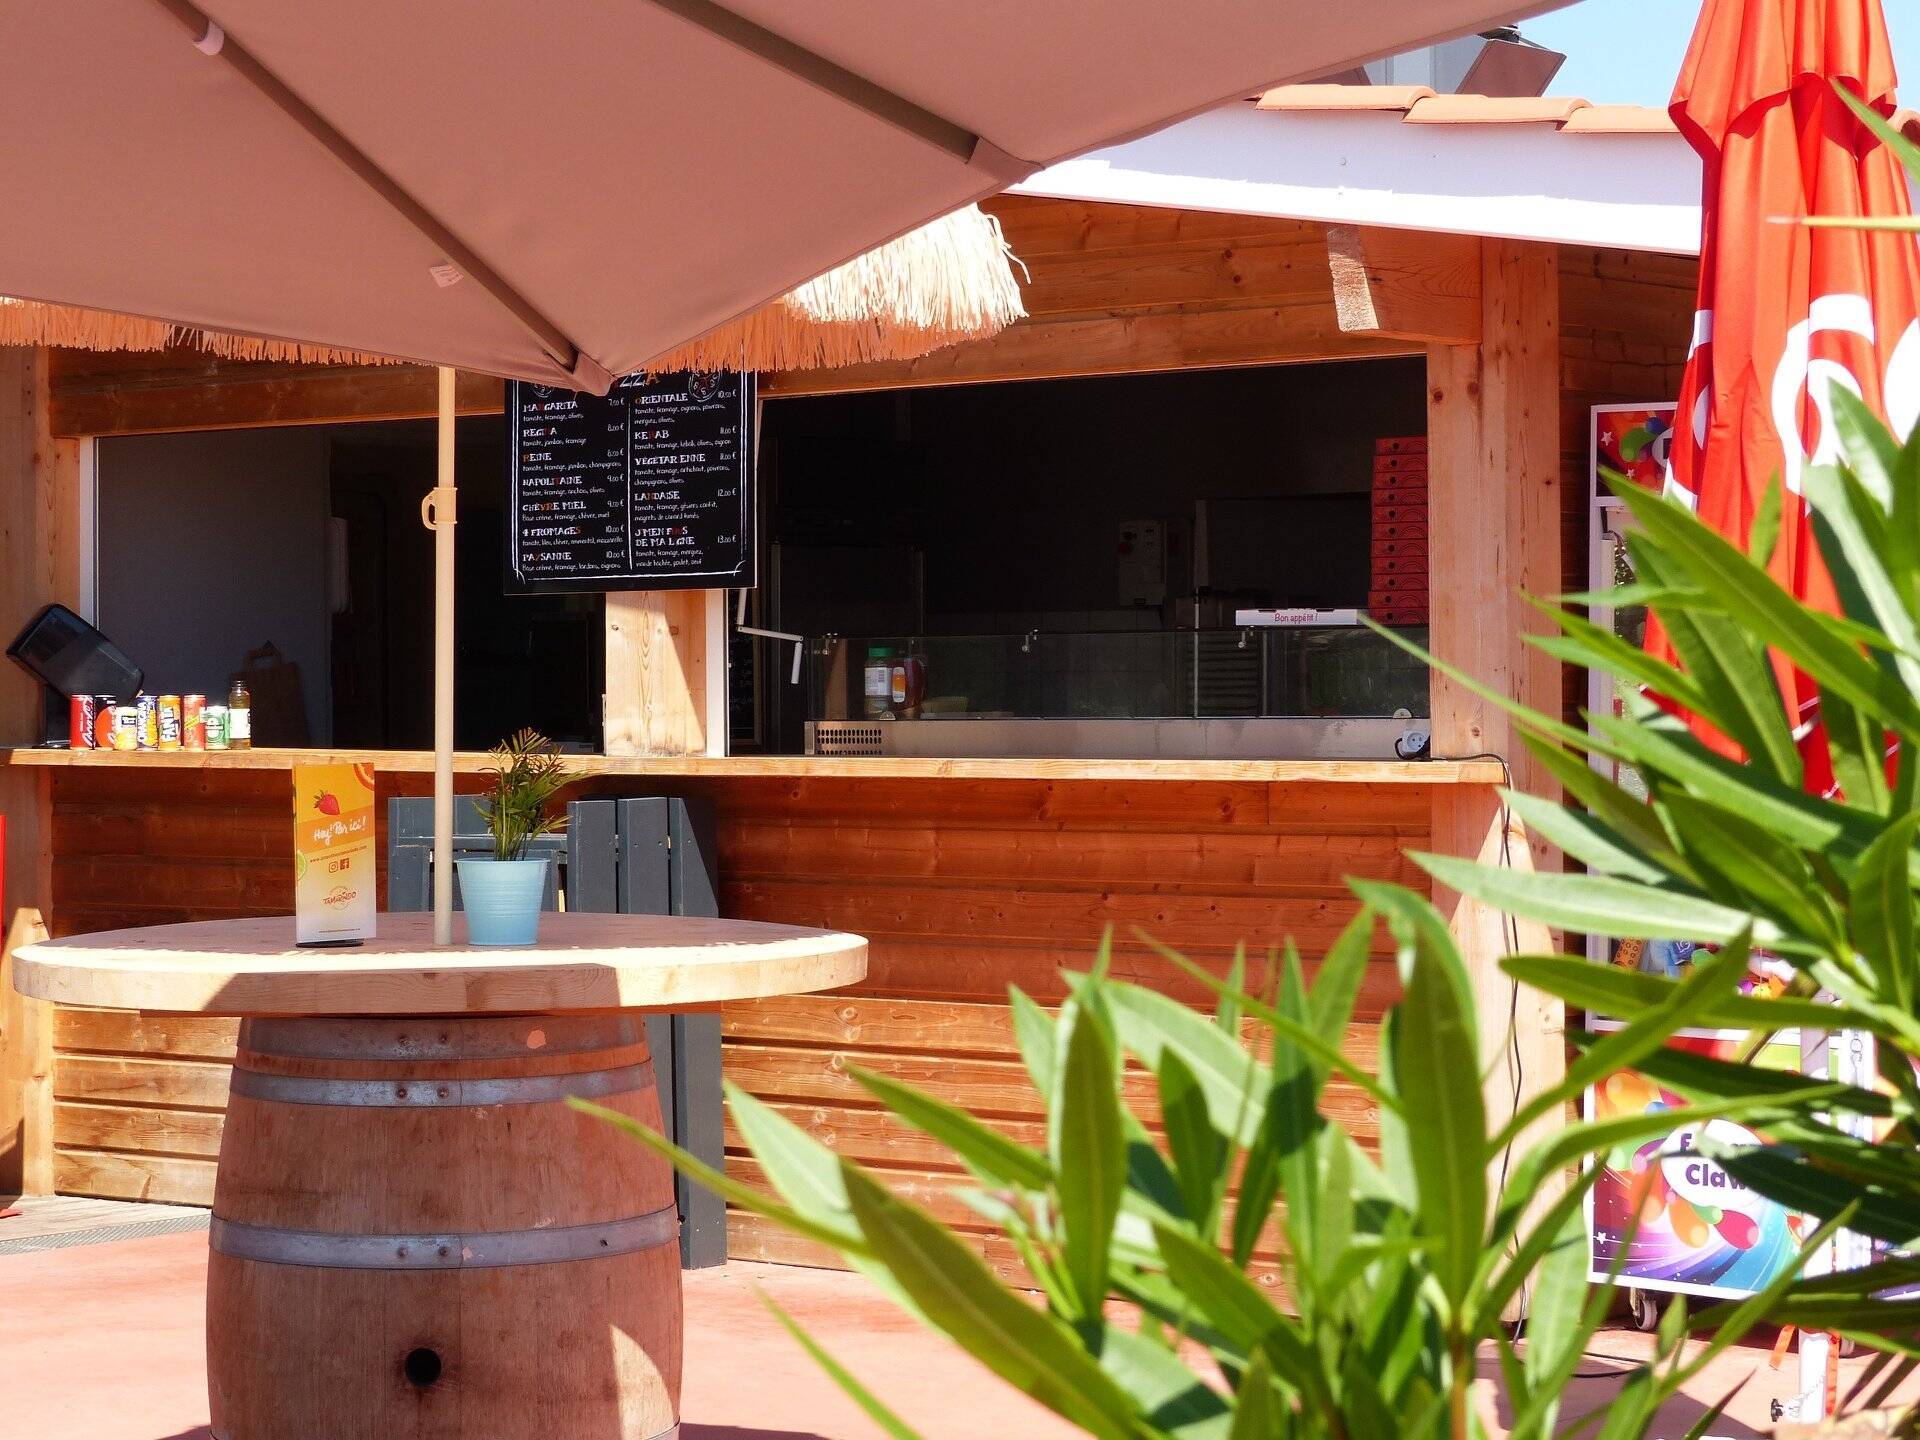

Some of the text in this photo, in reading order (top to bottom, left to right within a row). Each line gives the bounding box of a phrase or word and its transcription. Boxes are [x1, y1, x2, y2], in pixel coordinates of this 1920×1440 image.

[523, 401, 578, 412] MAGARITA
[523, 427, 557, 437] REGIA
[1274, 613, 1289, 622] Bon
[1290, 613, 1314, 625] appétit
